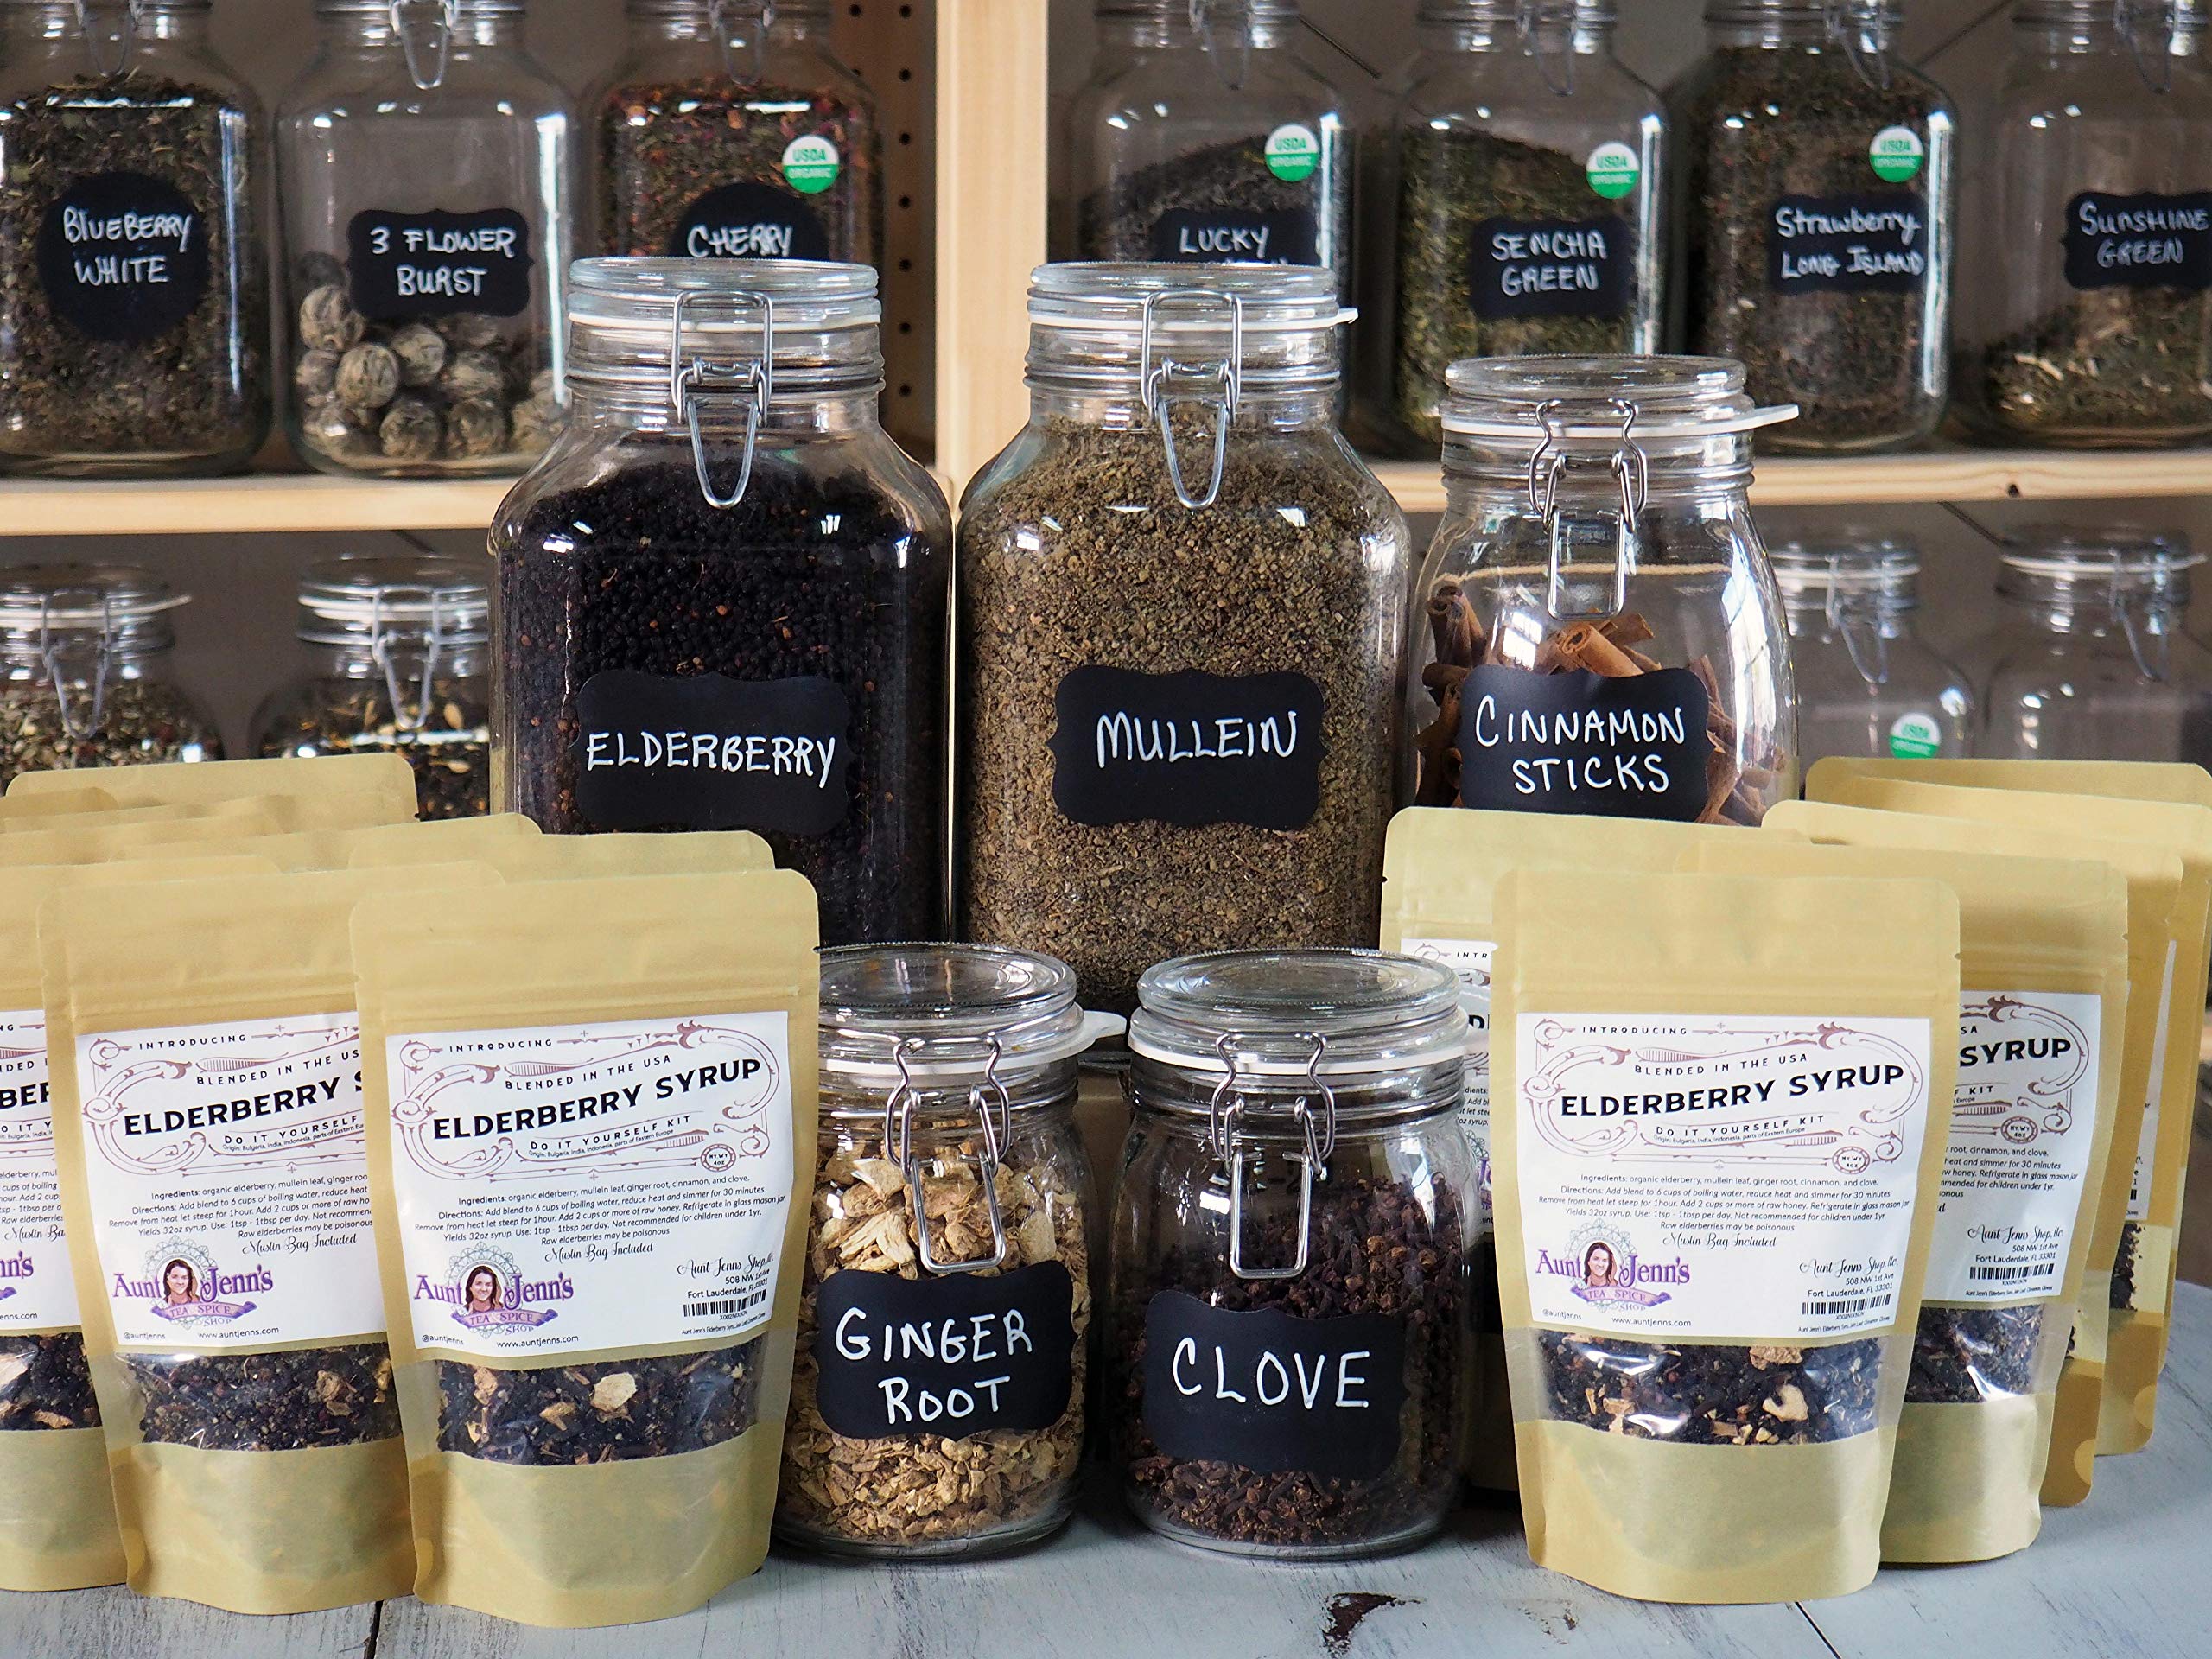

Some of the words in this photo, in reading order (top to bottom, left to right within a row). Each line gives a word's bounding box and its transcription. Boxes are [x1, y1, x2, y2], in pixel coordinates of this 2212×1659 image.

[793, 149, 826, 162] USDA
[1274, 138, 1306, 150] USDA
[1880, 140, 1911, 152] USDA
[1597, 156, 1628, 168] USDA
[687, 223, 794, 257] CHERRY
[1775, 206, 1922, 245] Strawberry
[370, 226, 390, 255] 3
[402, 227, 517, 258] FLOWER
[1179, 226, 1269, 259] LUCKY
[1491, 229, 1608, 261] SENCHA
[2097, 238, 2183, 268] GREEN
[74, 255, 170, 286] WHITE
[396, 264, 487, 296] BURST
[1501, 264, 1599, 296] GREEN
[1475, 695, 1685, 747] CINNAMON
[1096, 710, 1296, 768] MULLEIN
[587, 731, 836, 788] ELDERBERRY
[1513, 753, 1669, 794] STICKS
[139, 1033, 246, 1049] INTRODUCING
[449, 1039, 552, 1052] INTRODUCING
[1960, 1038, 2071, 1066] SYRUP
[197, 1071, 268, 1085] BLENDED
[278, 1065, 292, 1075] IN
[303, 1056, 331, 1070] THE
[505, 1076, 574, 1090] BLENDED
[583, 1071, 597, 1082] IN
[607, 1063, 634, 1076] THE
[644, 1055, 671, 1068] USA
[1635, 1065, 1706, 1076] BLENDED
[1715, 1063, 1729, 1072] IN
[1740, 1058, 1768, 1070] THE
[1779, 1053, 1808, 1064] USA
[433, 1084, 643, 1141] ELDERBERRY
[654, 1058, 761, 1100] SYRUP
[1560, 1080, 1775, 1117] ELDERBERRY
[1789, 1065, 1904, 1097] SYRUP
[1969, 1085, 1994, 1094] KIT
[124, 1076, 340, 1136] ELDERBERRY
[279, 1116, 358, 1139] YOURSELF
[558, 1141, 571, 1149] IT
[583, 1123, 658, 1146] YOURSELF
[667, 1116, 690, 1128] KIT
[635, 1133, 655, 1142] Eastern
[1710, 1120, 1789, 1135] YOURSELF
[1800, 1116, 1824, 1124] KIT
[438, 1211, 483, 1219] Directions:
[562, 1202, 569, 1211] of
[570, 1200, 594, 1209] boiling
[622, 1195, 646, 1205] reduce
[711, 1189, 721, 1198] for
[735, 1186, 764, 1195] minutes
[459, 1196, 505, 1206] Ingredients:
[509, 1192, 536, 1202] organic
[538, 1190, 578, 1198] elderberry,
[581, 1185, 608, 1195] mullein
[627, 1184, 651, 1192] ginger
[285, 1236, 308, 1254] Bag
[314, 1233, 357, 1247] Included
[585, 1243, 608, 1262] Bag
[612, 1242, 653, 1255] Included
[1706, 1232, 1728, 1249] Bag
[1734, 1233, 1777, 1247] Included
[1535, 1249, 1584, 1279] Aunt
[1618, 1256, 1690, 1288] Jenn's
[113, 1273, 162, 1298] Aunt
[200, 1264, 273, 1303] Jenn's
[414, 1273, 464, 1306] Aunt
[504, 1271, 574, 1311] Jenn's
[706, 1287, 747, 1297] Lauderdale,
[1827, 1287, 1864, 1296] Lauderdale,
[169, 1307, 188, 1316] TEA
[198, 1304, 231, 1314] SPICE
[470, 1313, 490, 1325] TEA
[499, 1312, 533, 1323] SPICE
[1612, 1316, 1691, 1326] www.auntjenns.com
[198, 1326, 279, 1339] www.auntjenns.com
[497, 1336, 579, 1348] www.auntjenns.com
[505, 1325, 534, 1335] SHOP
[835, 1306, 1033, 1363] GINGER
[1173, 1337, 1370, 1408] CLOVE
[877, 1376, 1011, 1424] ROOT
